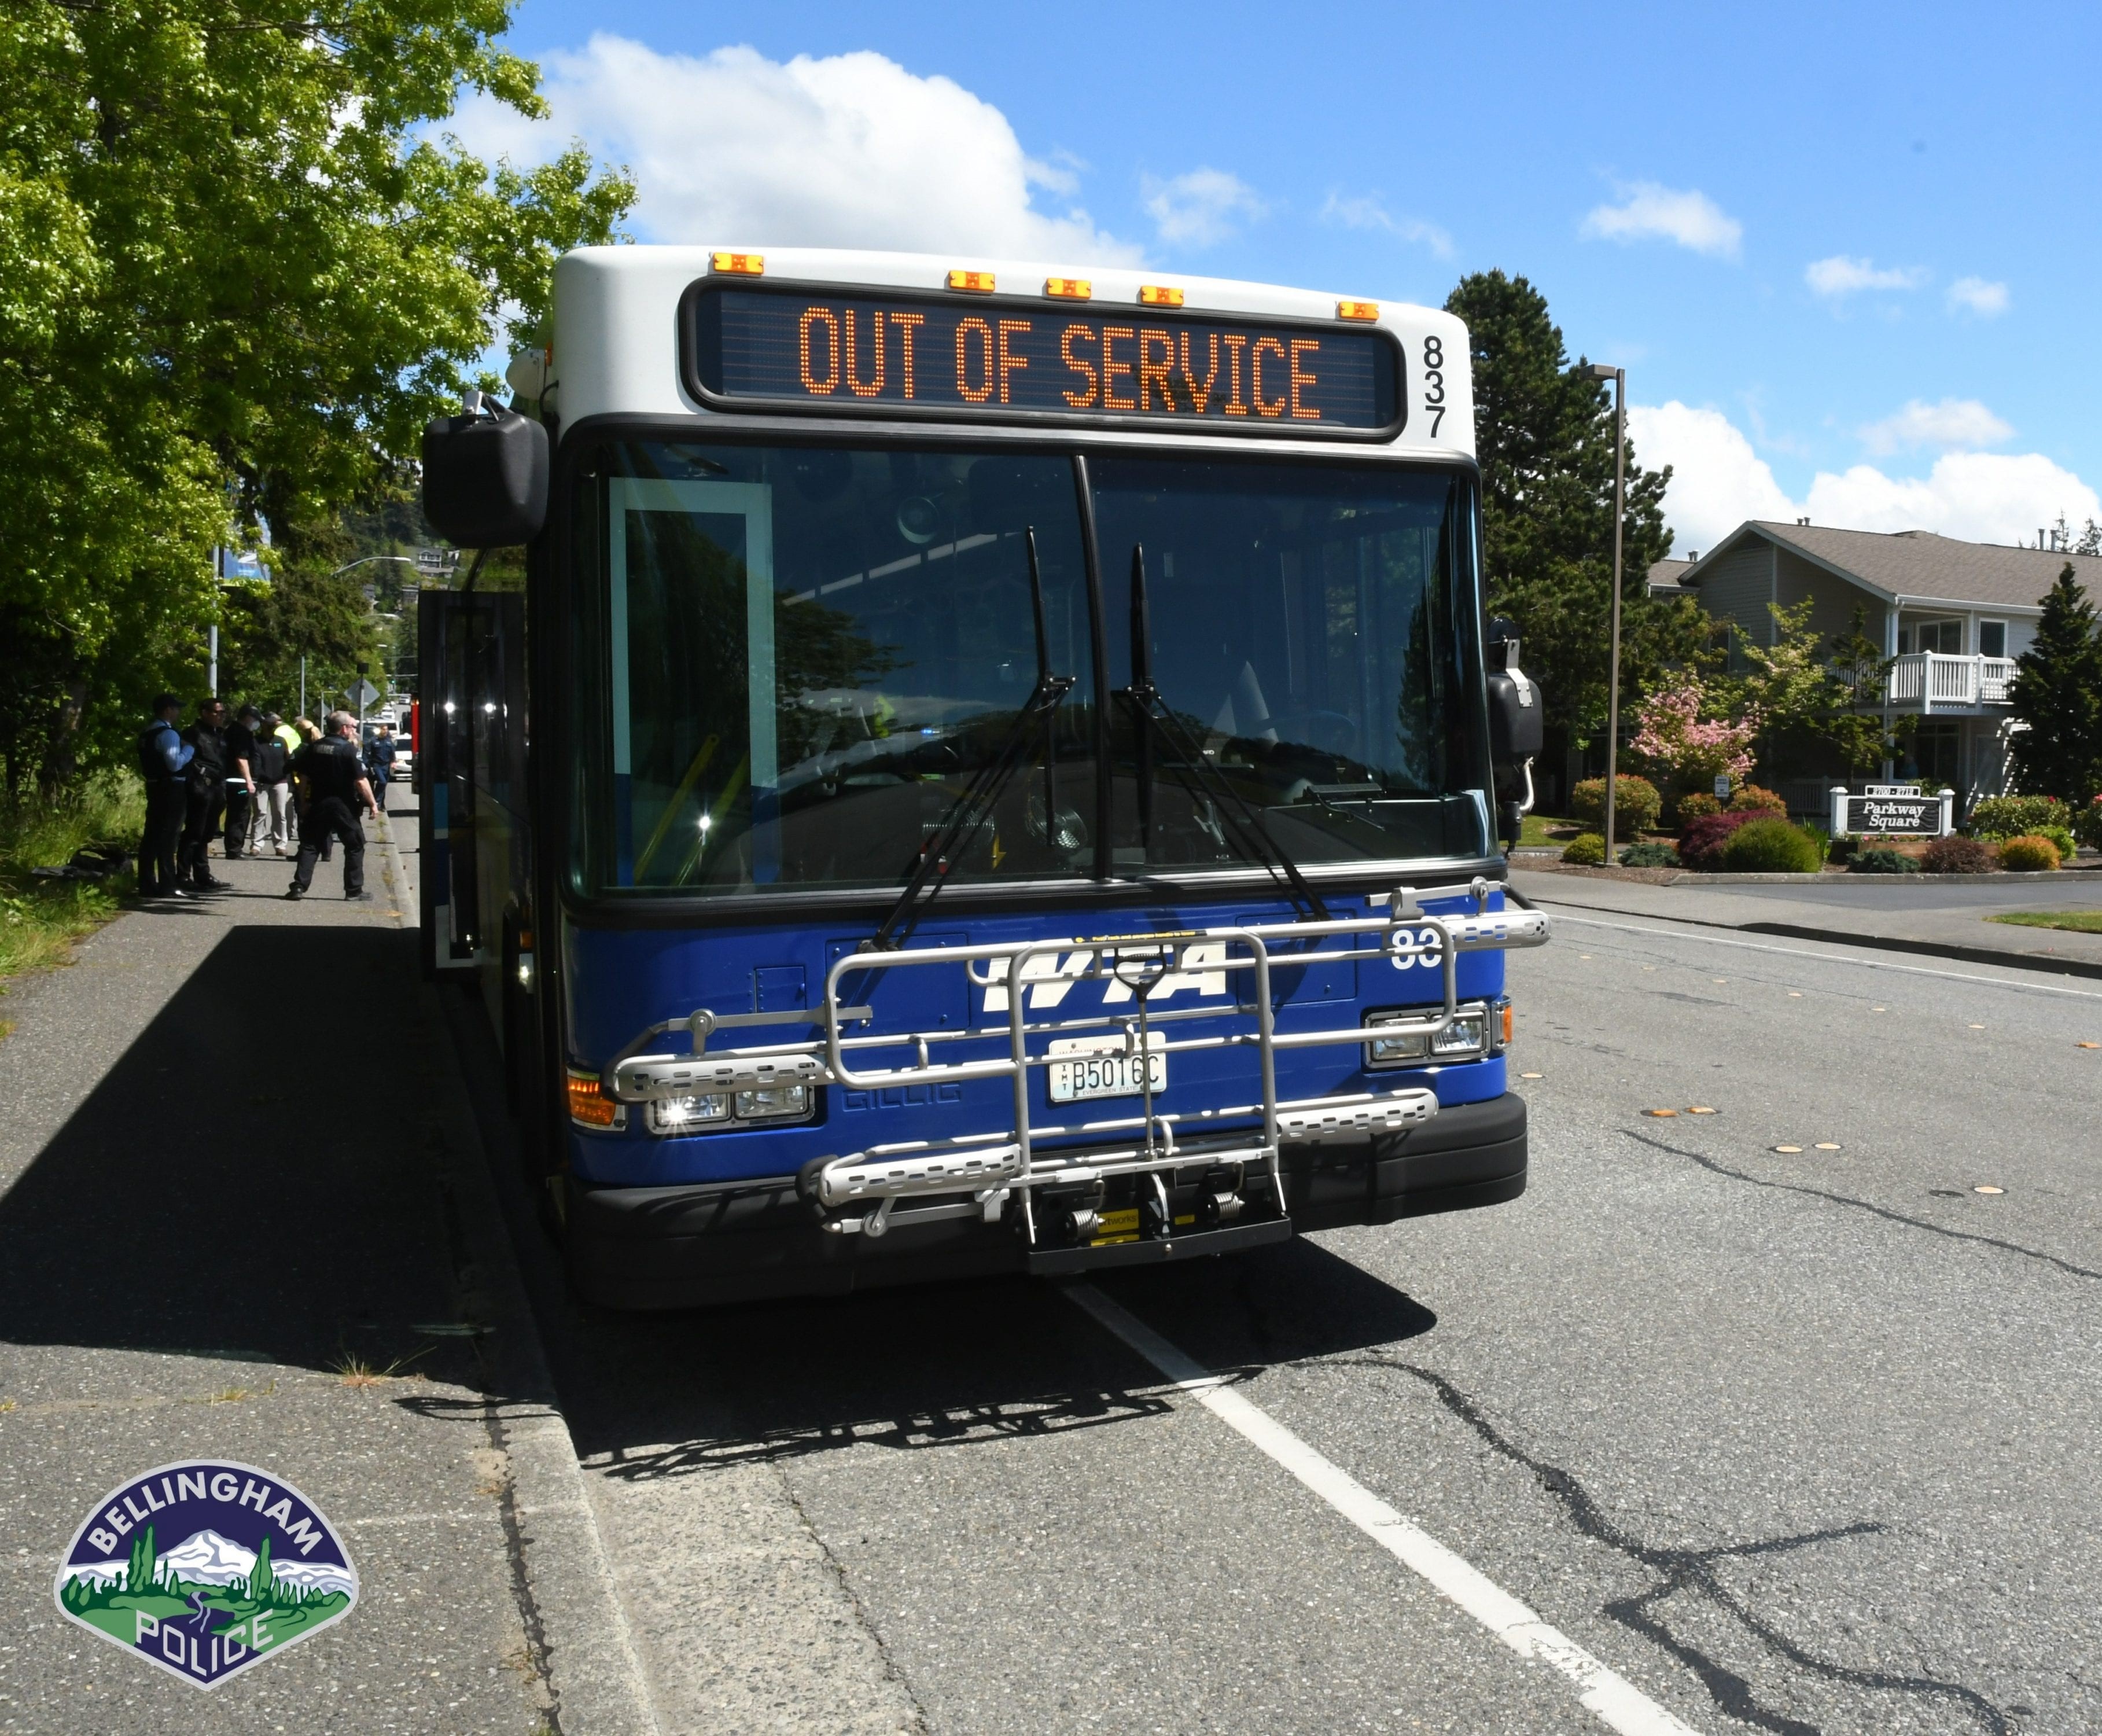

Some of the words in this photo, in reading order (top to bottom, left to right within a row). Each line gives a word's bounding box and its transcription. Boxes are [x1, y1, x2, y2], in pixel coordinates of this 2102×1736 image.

[798, 307, 925, 399] OUT
[956, 317, 1030, 404] OF
[1061, 323, 1321, 420] SERVICE
[1423, 335, 1446, 438] 837
[1862, 801, 1926, 818] Parkway
[1868, 814, 1920, 831] Square
[1391, 928, 1457, 970] 83
[983, 941, 1225, 1012] WTA
[1073, 1055, 1159, 1090] B5016C
[842, 1080, 960, 1112] GILLIG
[1083, 1087, 1116, 1095] EVERGREEN
